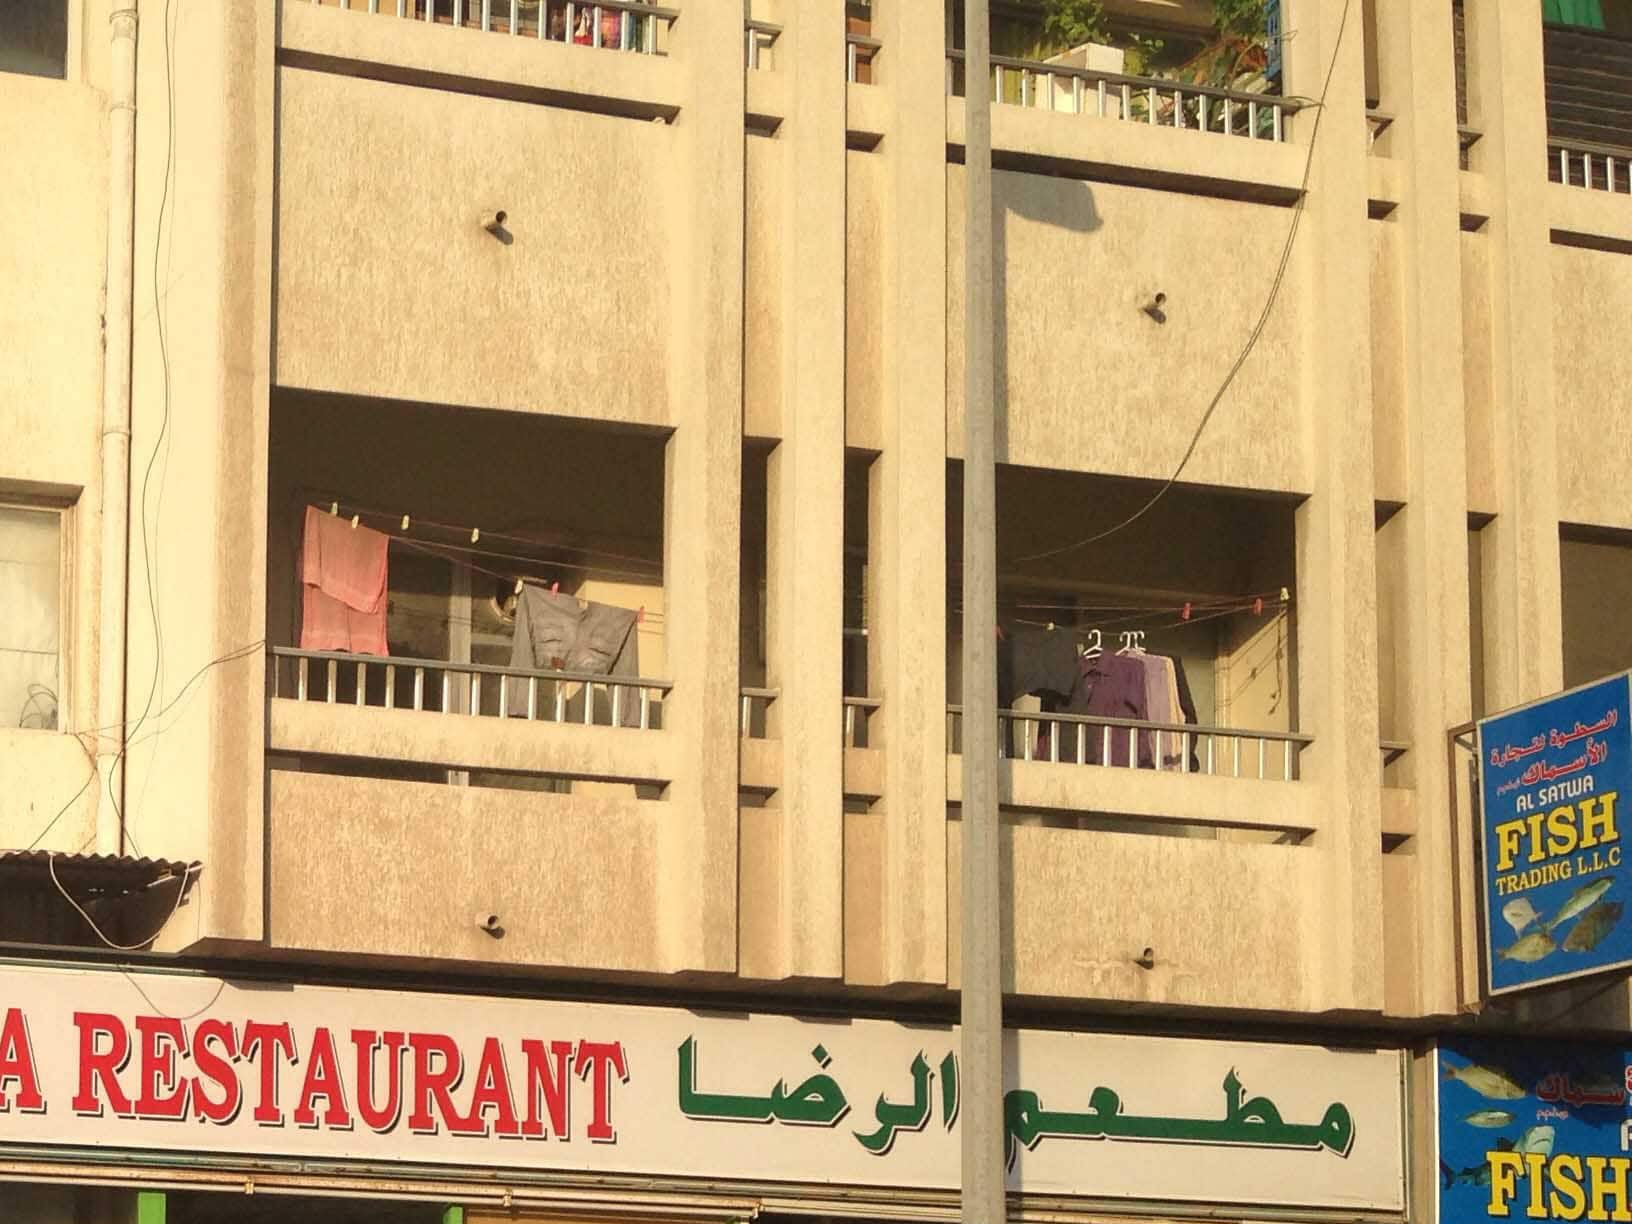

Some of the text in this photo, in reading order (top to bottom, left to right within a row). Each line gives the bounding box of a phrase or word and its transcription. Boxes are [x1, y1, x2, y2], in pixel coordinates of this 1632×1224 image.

[1495, 792, 1619, 872] FISH
[1516, 788, 1535, 813] AL
[1538, 775, 1595, 807] SATWA
[1495, 846, 1622, 896] TRADING L.L.C
[71, 1011, 630, 1145] RESTAURANT
[678, 1034, 1355, 1174] مطعم الرضا
[1486, 1150, 1632, 1223] FISH
